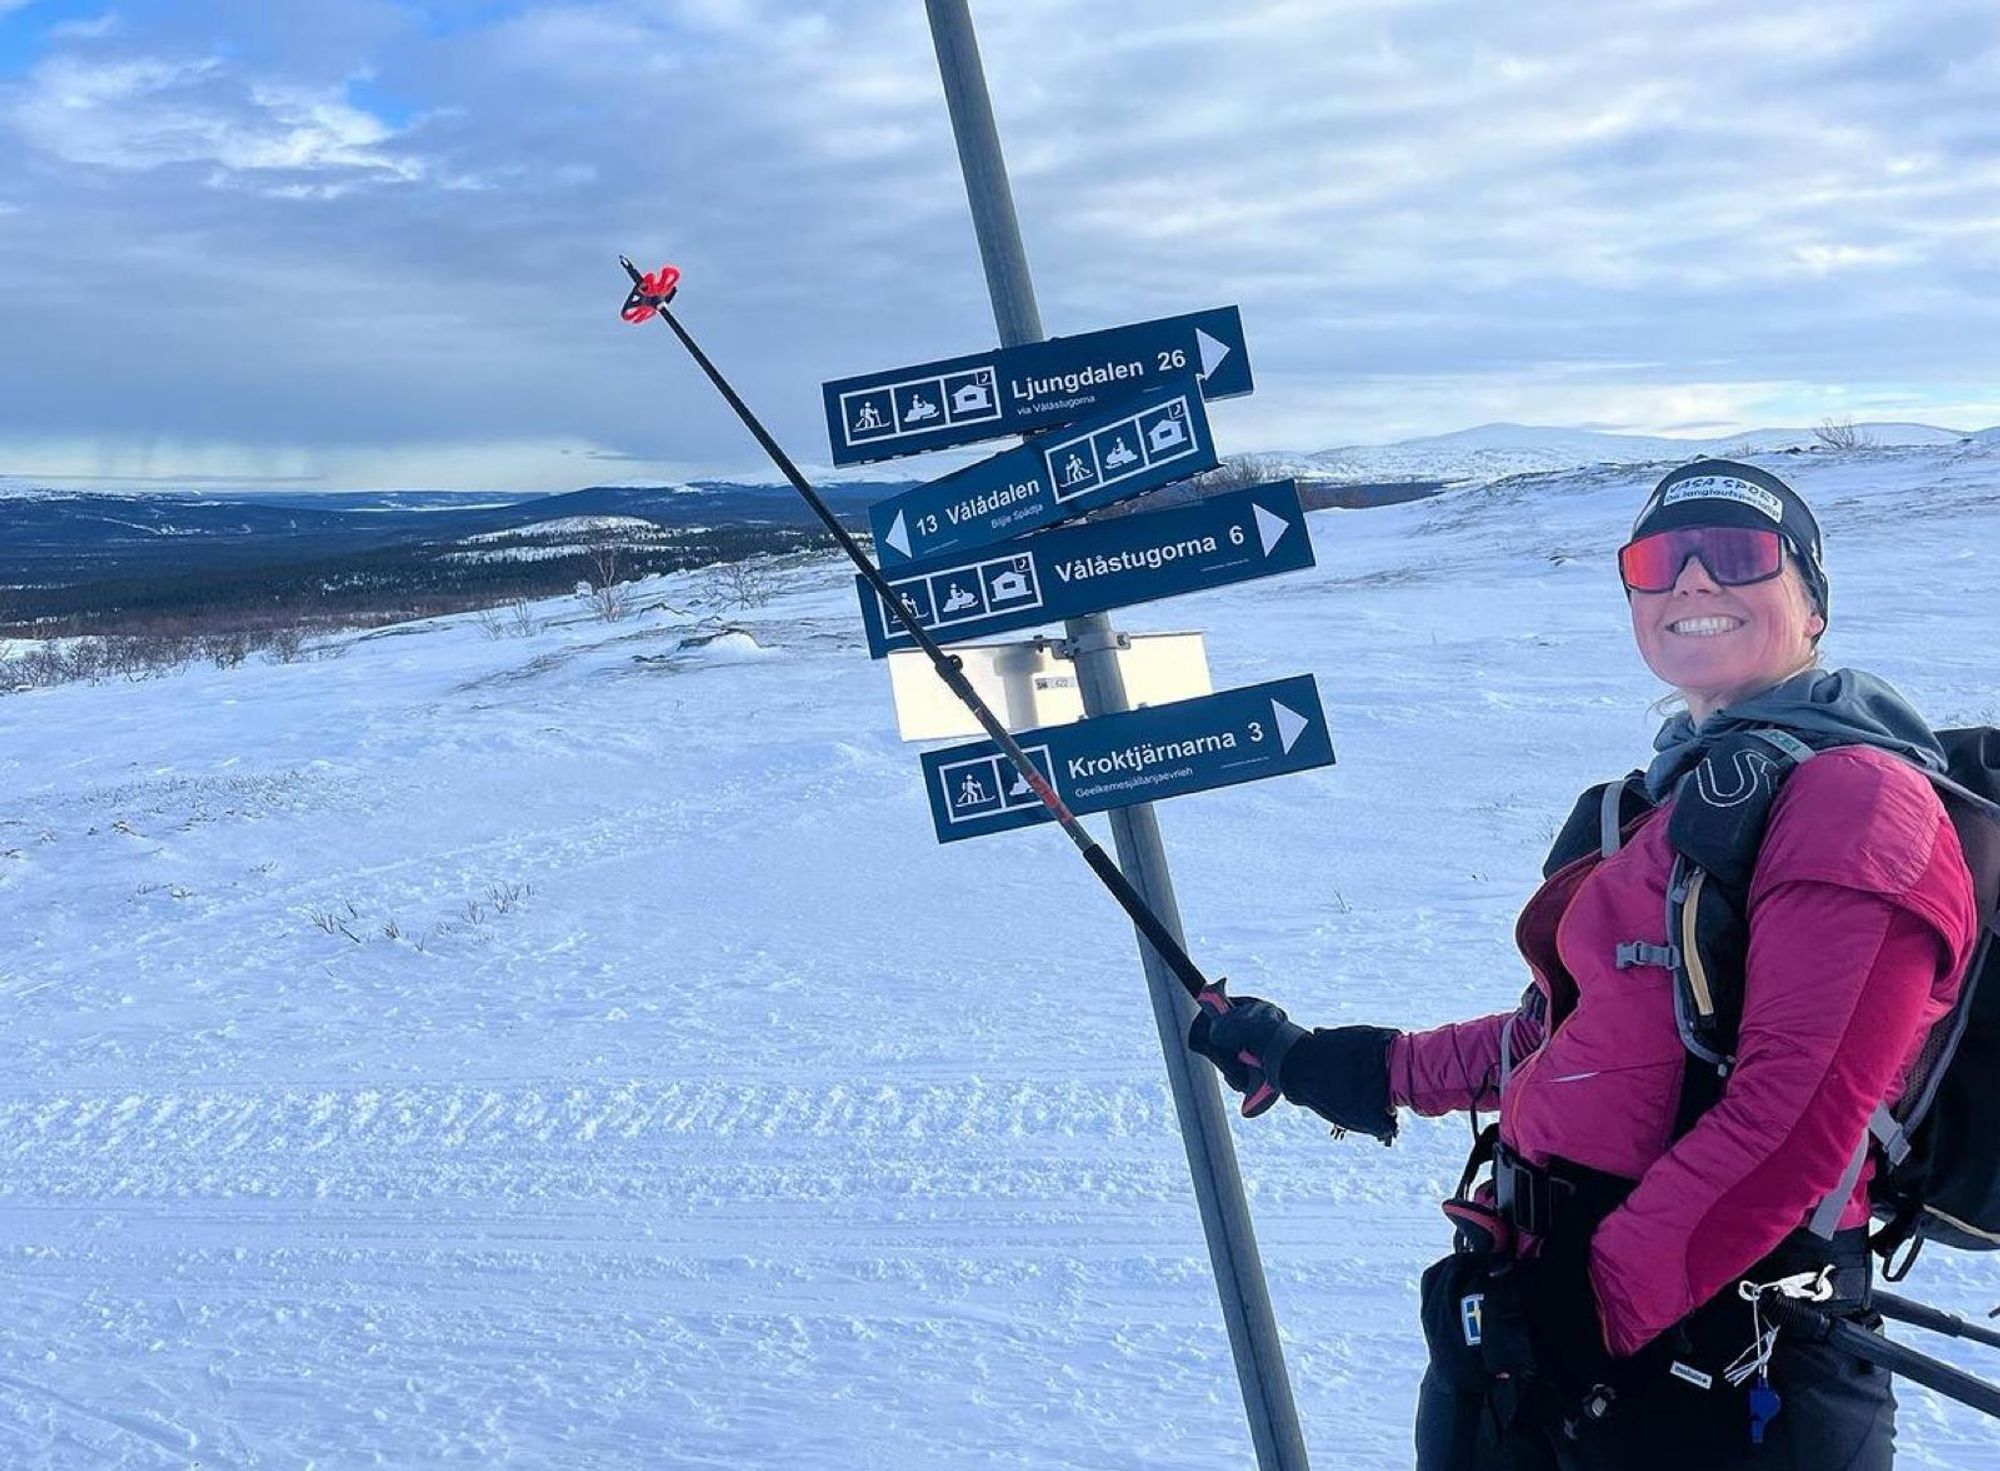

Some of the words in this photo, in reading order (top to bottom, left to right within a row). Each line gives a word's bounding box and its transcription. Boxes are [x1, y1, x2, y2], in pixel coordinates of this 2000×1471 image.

[1011, 361, 1144, 401] Ljungdalen
[1157, 349, 1187, 372] 26
[916, 514, 938, 536] 13
[945, 479, 1040, 525] Vålådalen
[1055, 535, 1217, 583] Vålåstugorna
[1229, 525, 1244, 546] 6
[1068, 732, 1237, 780] Kroktjärnarna
[1248, 722, 1264, 743] 3
